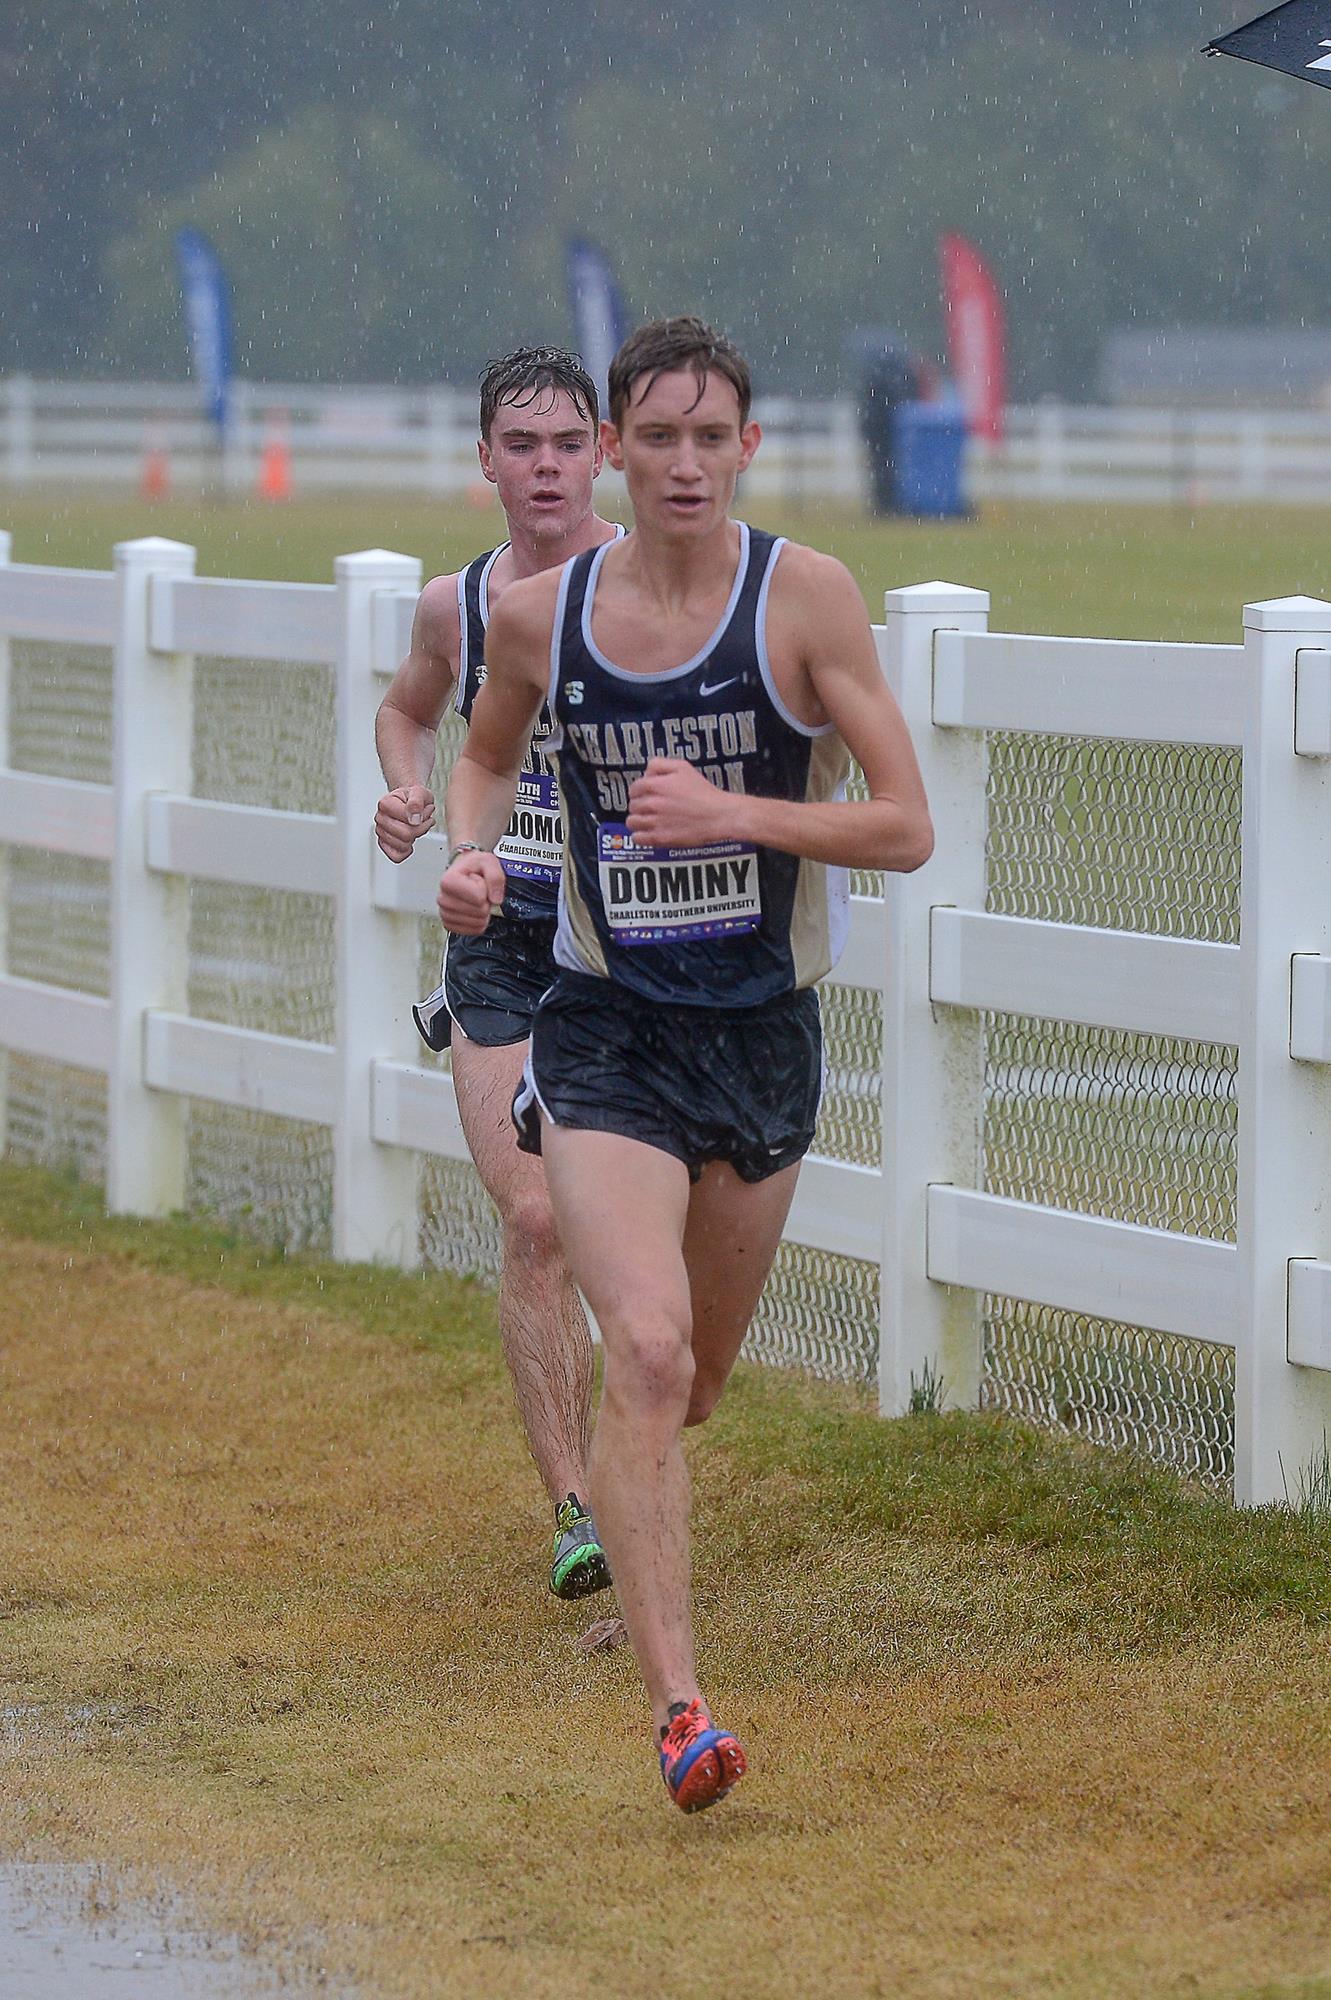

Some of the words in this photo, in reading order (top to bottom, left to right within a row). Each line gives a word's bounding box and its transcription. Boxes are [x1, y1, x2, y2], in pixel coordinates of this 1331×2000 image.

[566, 710, 758, 766] CHARLESTON
[517, 781, 541, 796] UTH
[594, 761, 746, 812] SORN
[499, 844, 542, 858] CHARLESTON
[542, 850, 564, 861] SOUTH
[668, 843, 743, 858] CHAMPIONSHIPS
[608, 859, 751, 905] DOMINY
[609, 909, 660, 921] CHARLESTON
[662, 906, 705, 919] SOUTHERN
[706, 899, 755, 913] UNIVERSITY
